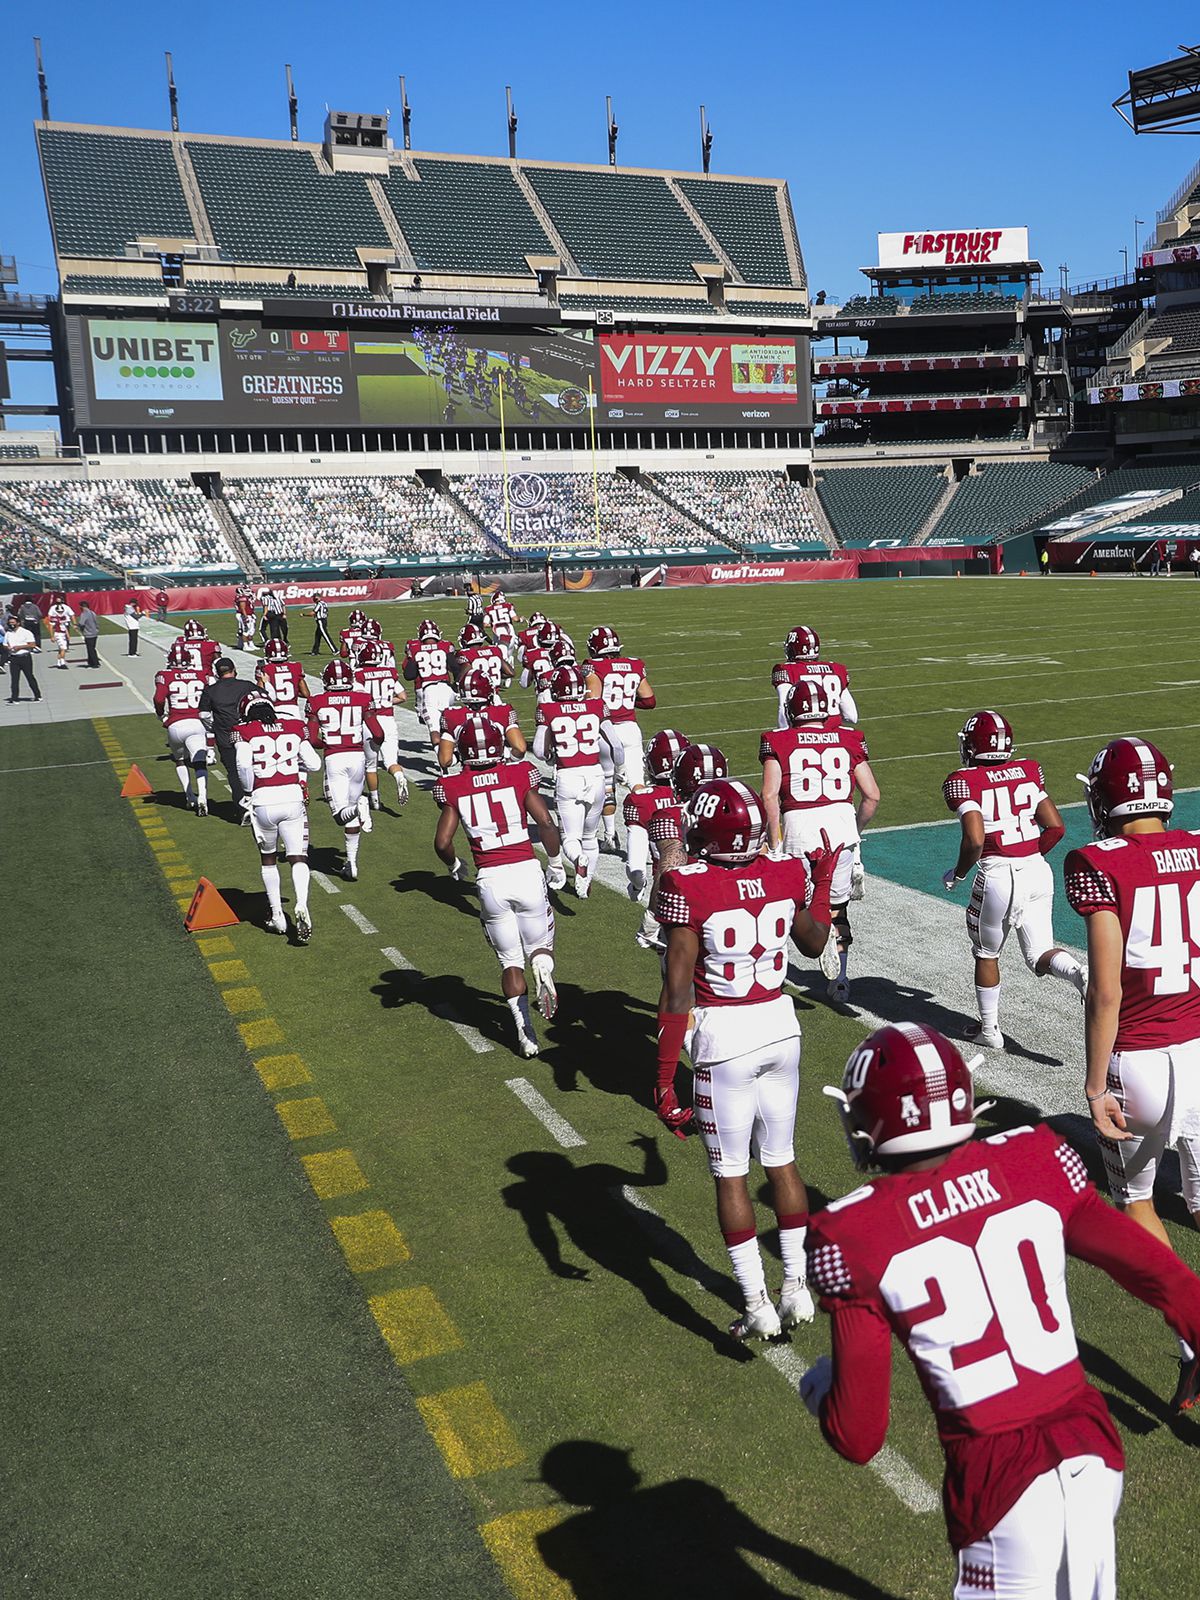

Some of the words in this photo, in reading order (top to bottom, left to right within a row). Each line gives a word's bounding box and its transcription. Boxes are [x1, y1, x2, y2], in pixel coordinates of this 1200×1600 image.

[945, 250, 992, 264] BANK
[177, 298, 215, 313] 3:22
[349, 303, 401, 318] Lincoln
[402, 305, 465, 320] Financial
[466, 307, 500, 321] Field
[854, 319, 876, 327] 78247
[270, 331, 279, 344] 0
[300, 332, 309, 345] 0
[92, 337, 214, 362] UNIBET
[601, 344, 723, 376] VIZZY
[242, 375, 343, 394] GREATNESS
[617, 378, 654, 388] HARD
[660, 378, 716, 388] SELTZER
[272, 396, 300, 405] DOESN'T
[741, 409, 770, 418] verizon
[492, 512, 561, 532] Alstate
[610, 546, 708, 558] BIRDS
[489, 608, 510, 624] 15
[415, 649, 447, 678] 39
[169, 680, 205, 709] 26
[274, 672, 295, 701] 5
[602, 673, 641, 710] 69
[328, 696, 351, 705] BROWN
[560, 702, 587, 713] WILSON
[317, 706, 363, 745] 24
[551, 714, 600, 758] 33
[798, 732, 840, 744] EISENSON
[250, 733, 301, 778] 38
[472, 773, 499, 787] ODOM
[788, 747, 852, 802] 68
[986, 767, 1027, 783] McCARGO
[694, 792, 720, 818] 88
[981, 781, 1042, 847] 42
[1126, 801, 1169, 812] TEMPLE
[458, 786, 529, 852] 41
[1151, 847, 1200, 874] BARRY
[736, 878, 766, 901] FOX
[703, 898, 797, 998] 88
[907, 1167, 1002, 1231] CLARK
[878, 1199, 1079, 1410] 20
